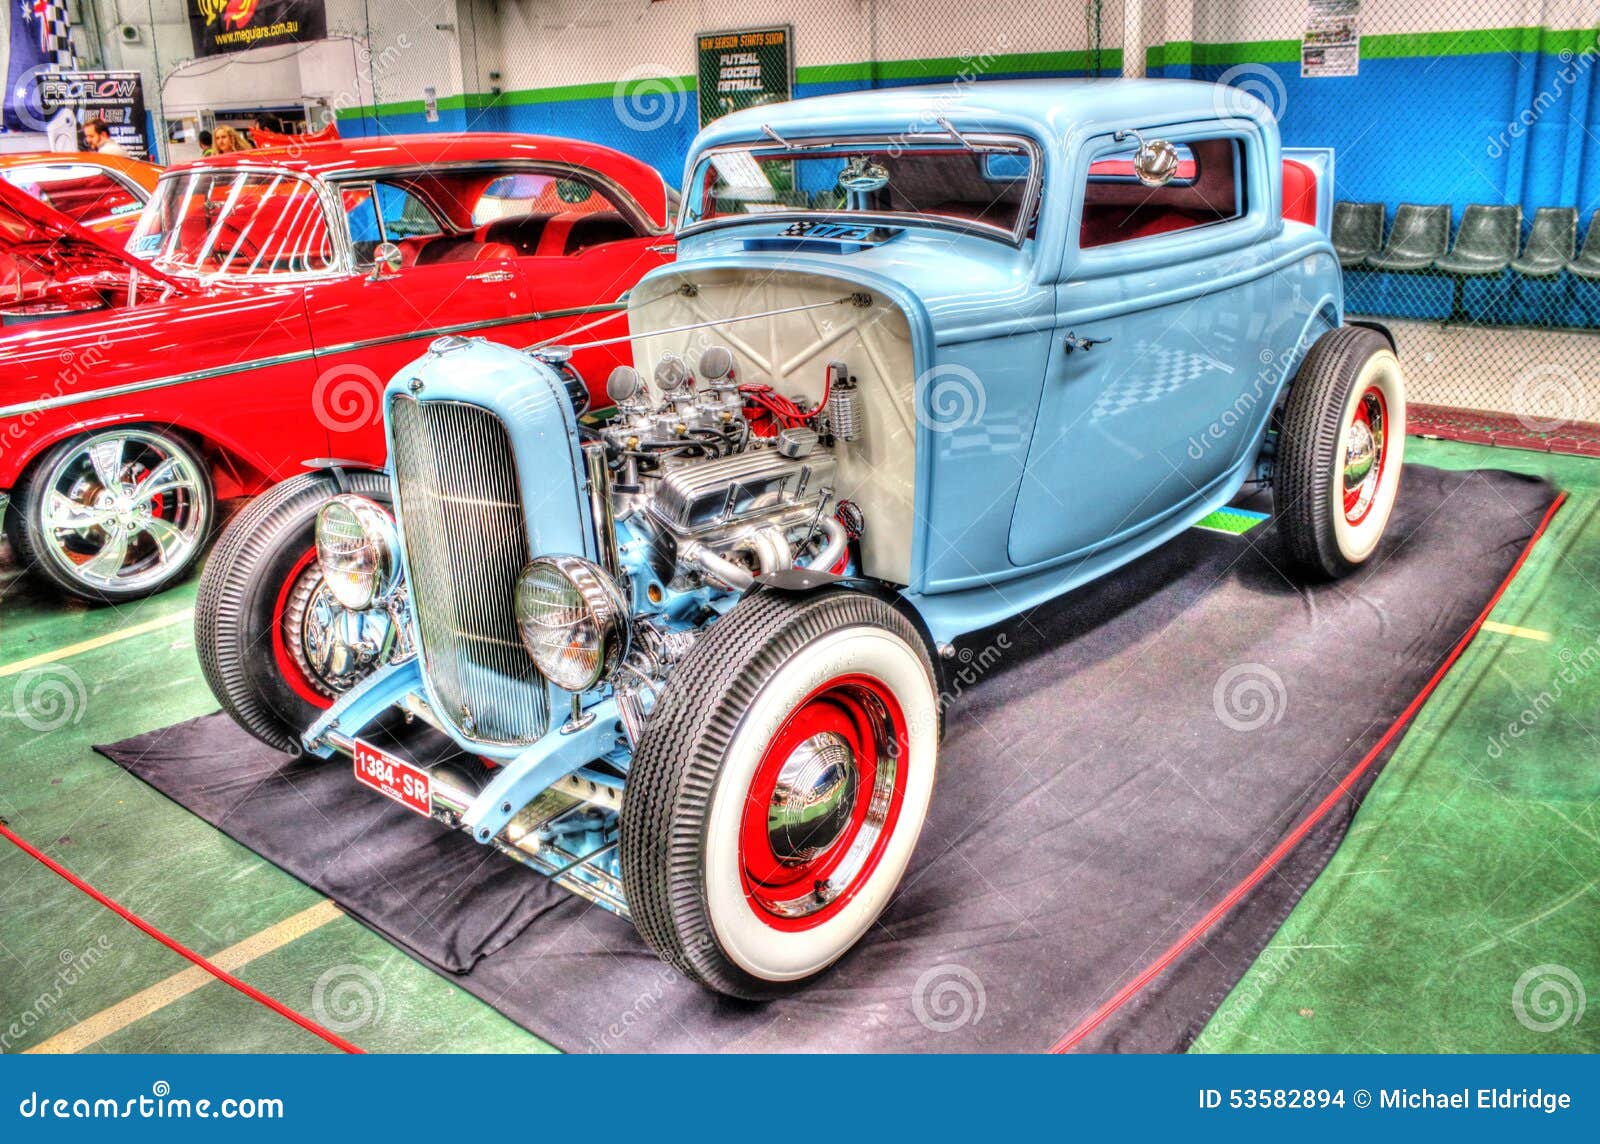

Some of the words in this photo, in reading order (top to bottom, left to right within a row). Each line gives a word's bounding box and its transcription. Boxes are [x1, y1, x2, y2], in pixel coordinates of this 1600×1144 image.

[215, 21, 299, 44] www.meguiars.com.au
[720, 52, 760, 66] FUTSAL
[720, 65, 761, 79] SOCCER
[44, 80, 136, 99] PROFLOW
